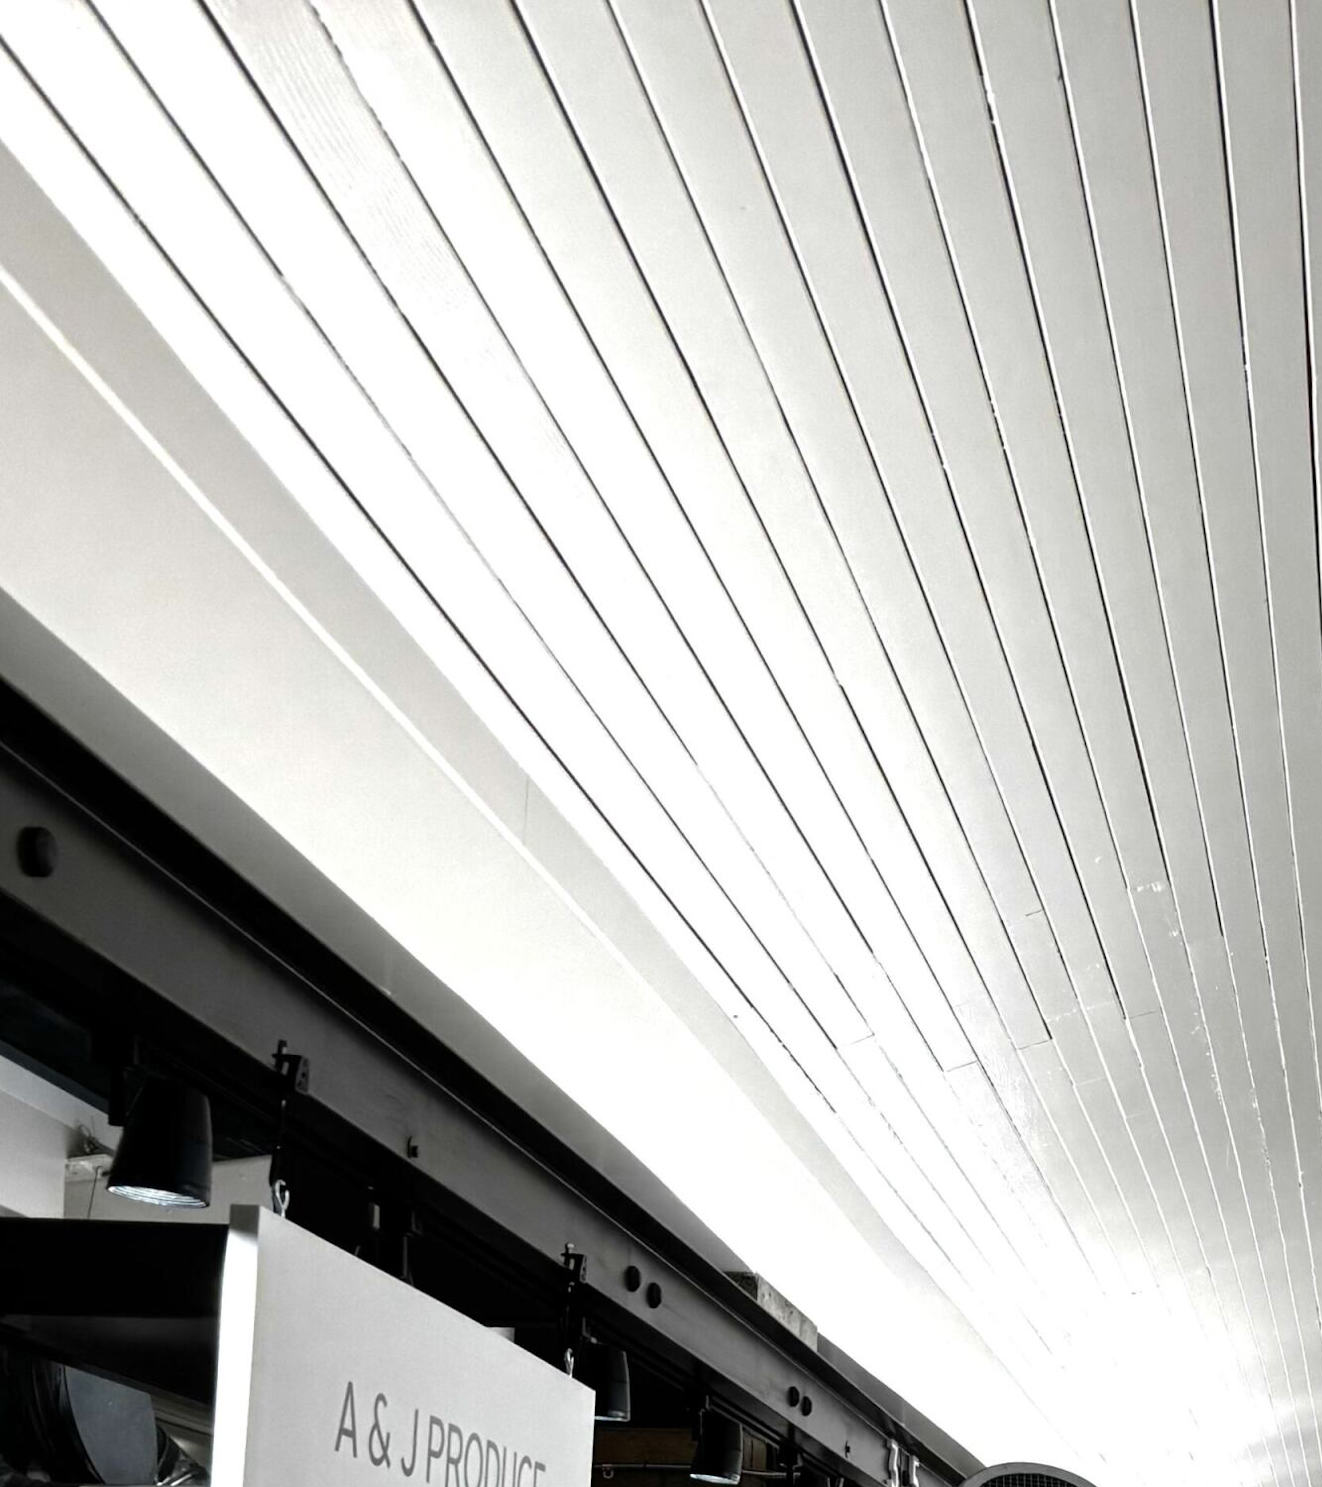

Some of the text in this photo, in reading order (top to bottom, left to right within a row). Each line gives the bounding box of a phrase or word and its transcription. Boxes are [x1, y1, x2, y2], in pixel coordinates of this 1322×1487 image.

[334, 1380, 359, 1459] A
[367, 1391, 392, 1469] &
[400, 1402, 419, 1478] J
